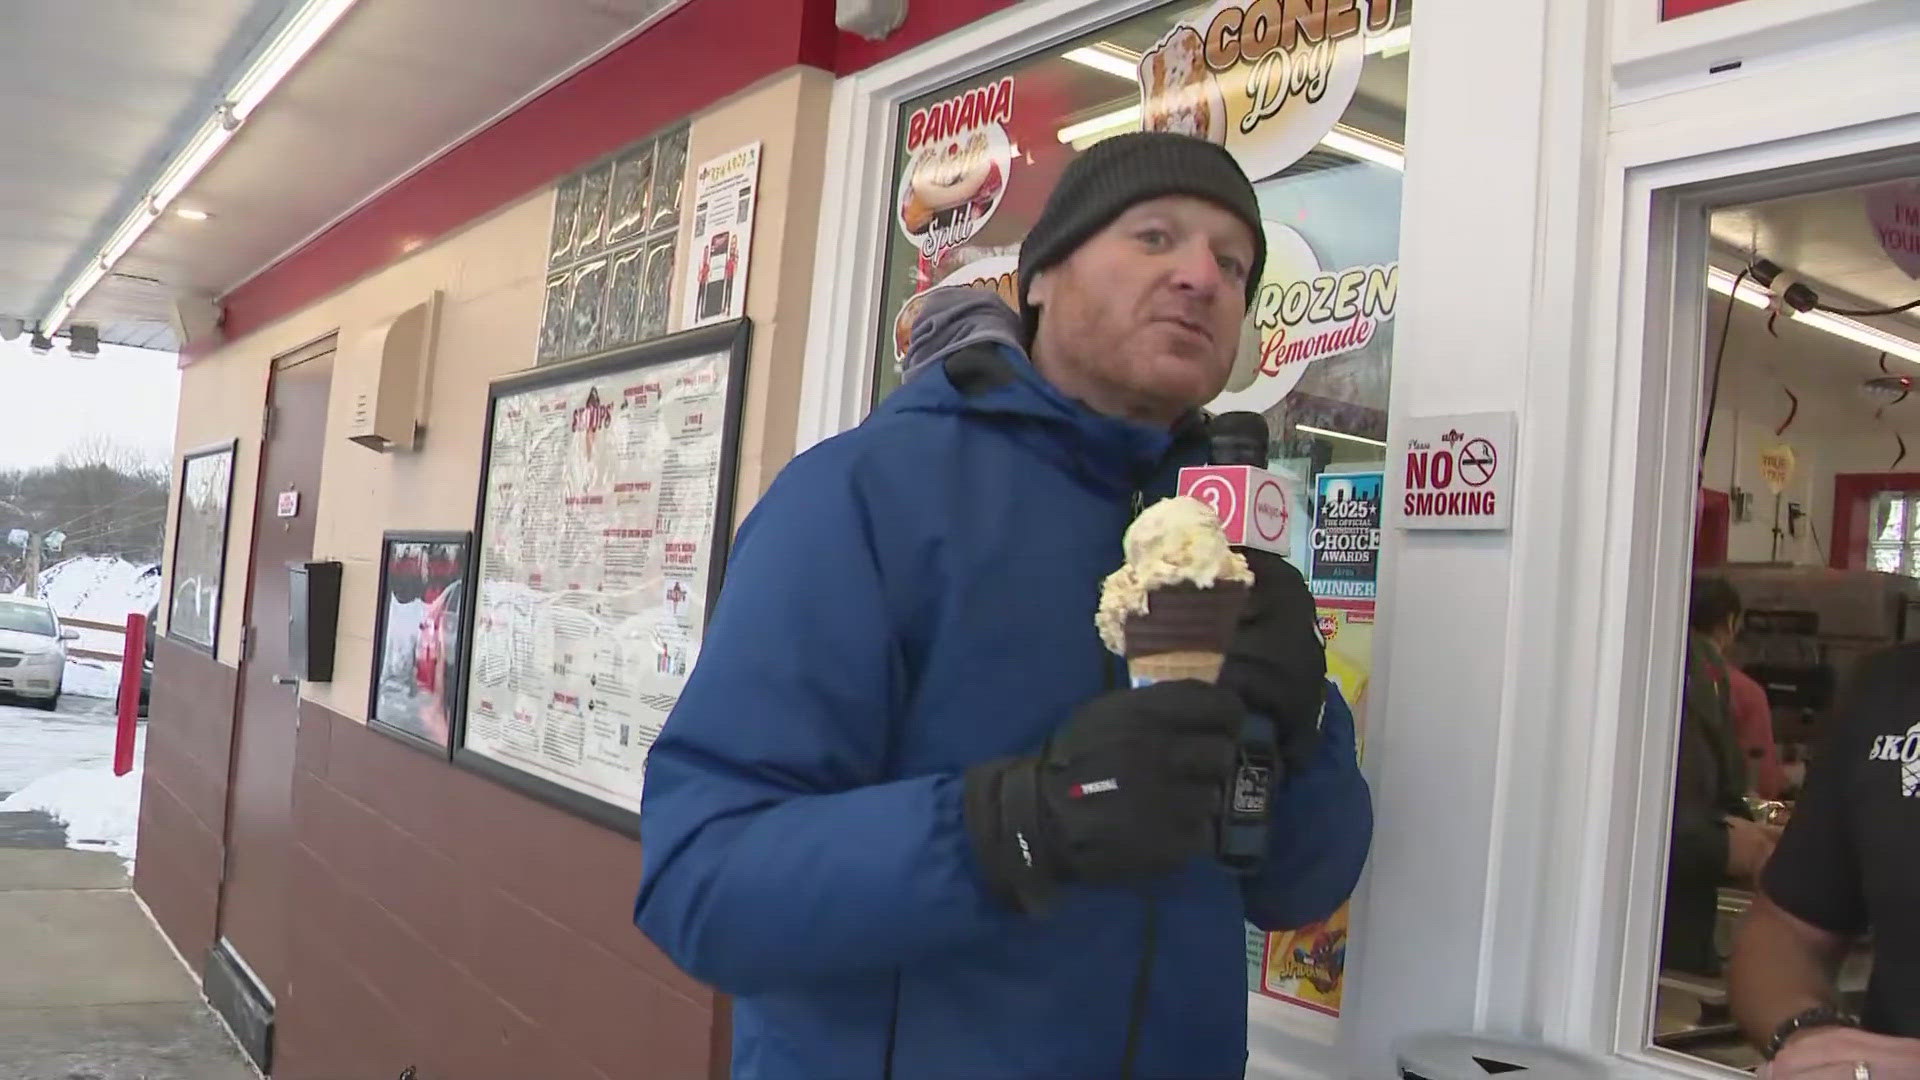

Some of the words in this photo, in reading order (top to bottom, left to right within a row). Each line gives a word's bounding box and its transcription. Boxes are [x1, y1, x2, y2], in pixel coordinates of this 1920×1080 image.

[1241, 36, 1336, 134] Dog
[908, 79, 1012, 151] BANANA
[923, 203, 973, 266] Split
[1254, 266, 1398, 328] ROZEN
[1253, 310, 1370, 377] Lemonade
[1406, 451, 1453, 489] NO
[1329, 501, 1368, 518] 2025
[1404, 491, 1495, 516] SMOKING
[1311, 528, 1380, 550] CHOICE
[1321, 551, 1370, 562] AWARDS
[1314, 580, 1375, 596] WINNER
